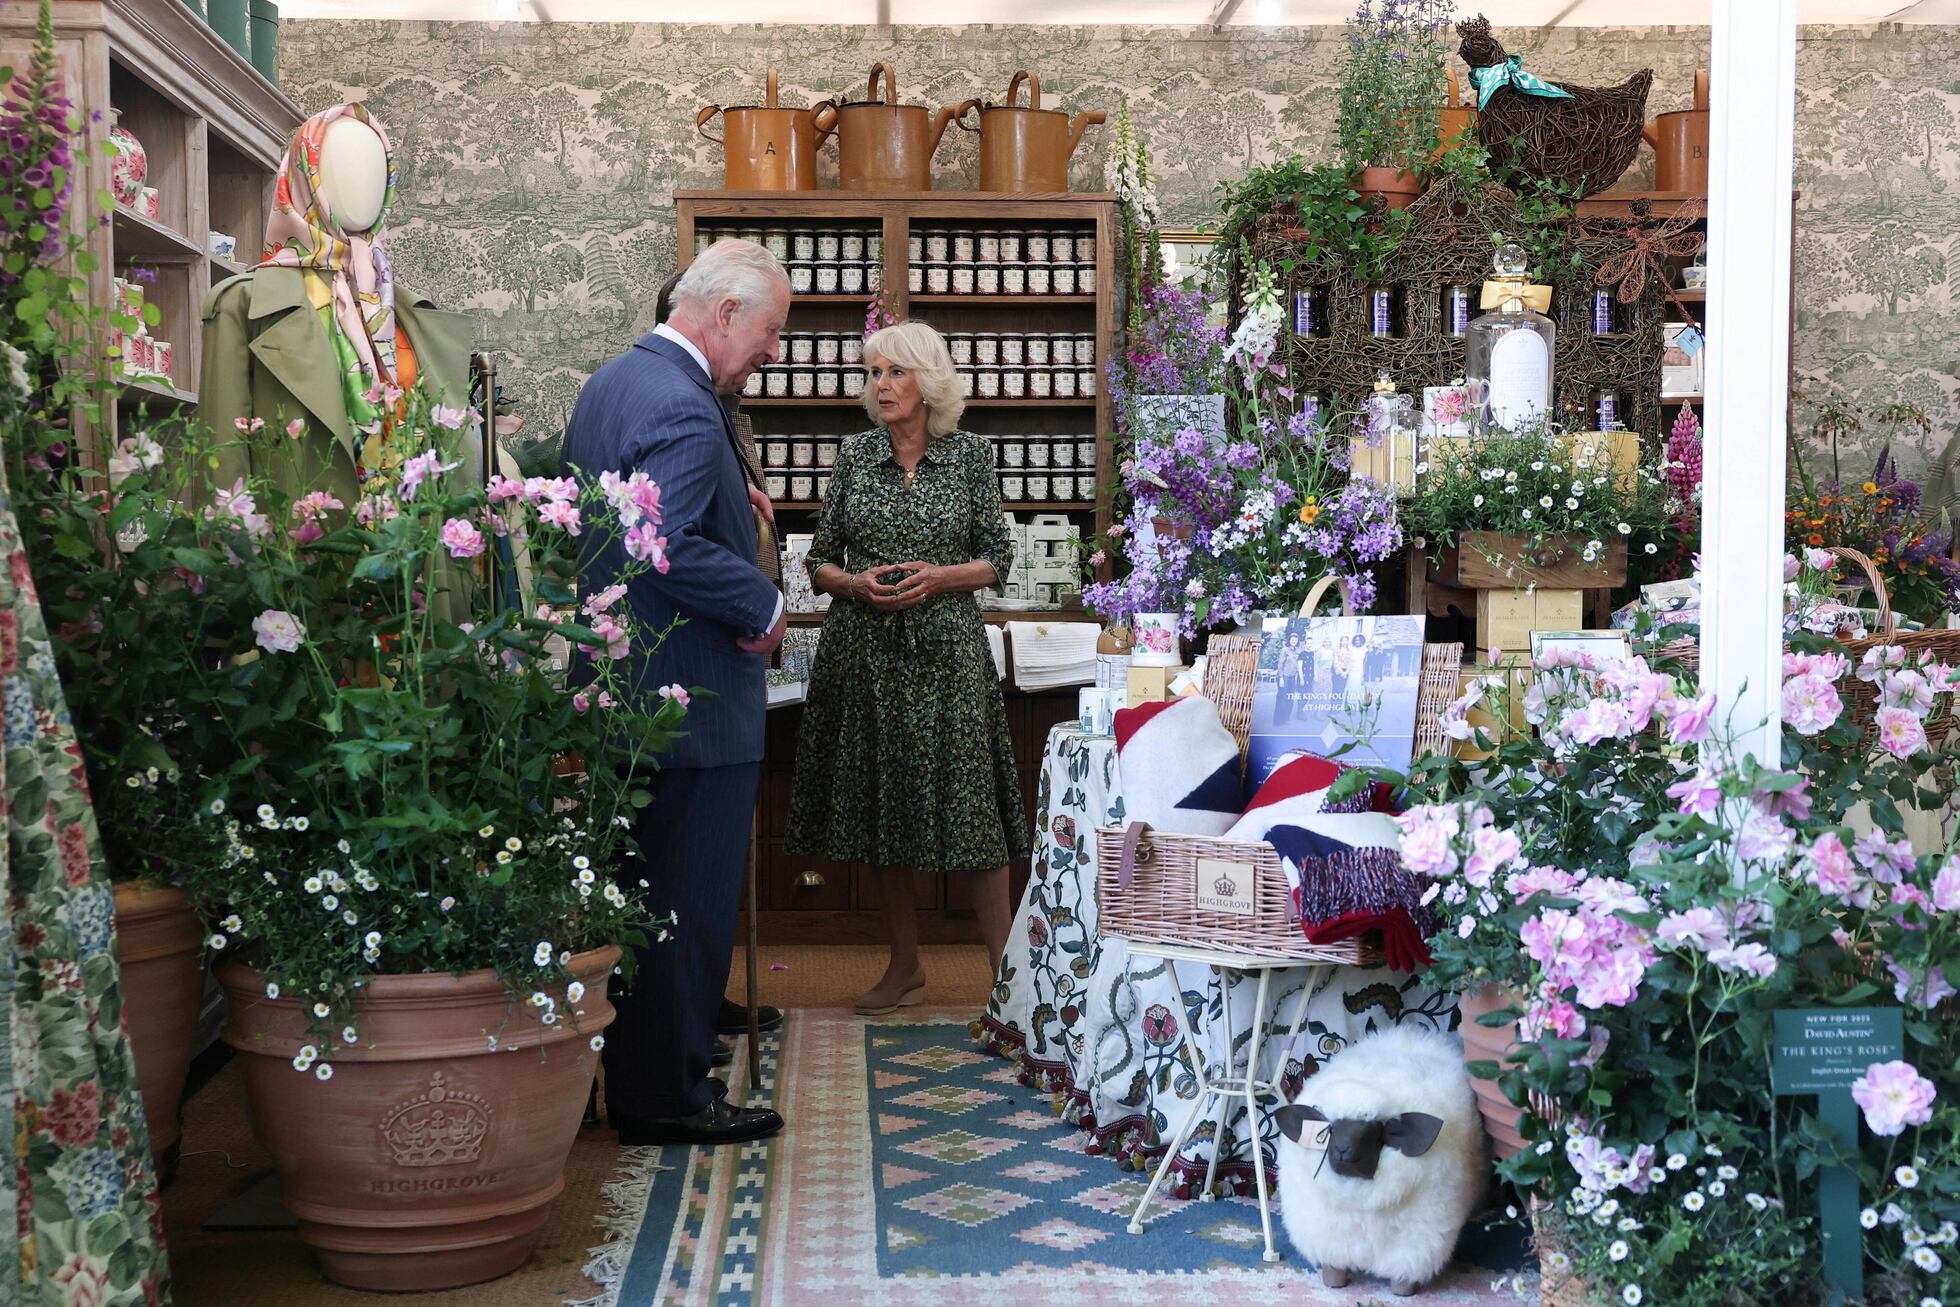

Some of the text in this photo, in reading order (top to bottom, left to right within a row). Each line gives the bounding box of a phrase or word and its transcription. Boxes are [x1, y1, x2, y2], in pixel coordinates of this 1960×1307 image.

[765, 141, 776, 155] A
[1693, 145, 1702, 159] B
[1286, 692, 1302, 701] THE
[1199, 896, 1251, 910] HIGHGROVE
[1806, 1015, 1827, 1023] NEW
[1782, 1046, 1806, 1056] THE
[1811, 1046, 1853, 1056] KING'S
[371, 1172, 498, 1194] HIGHGROVE
